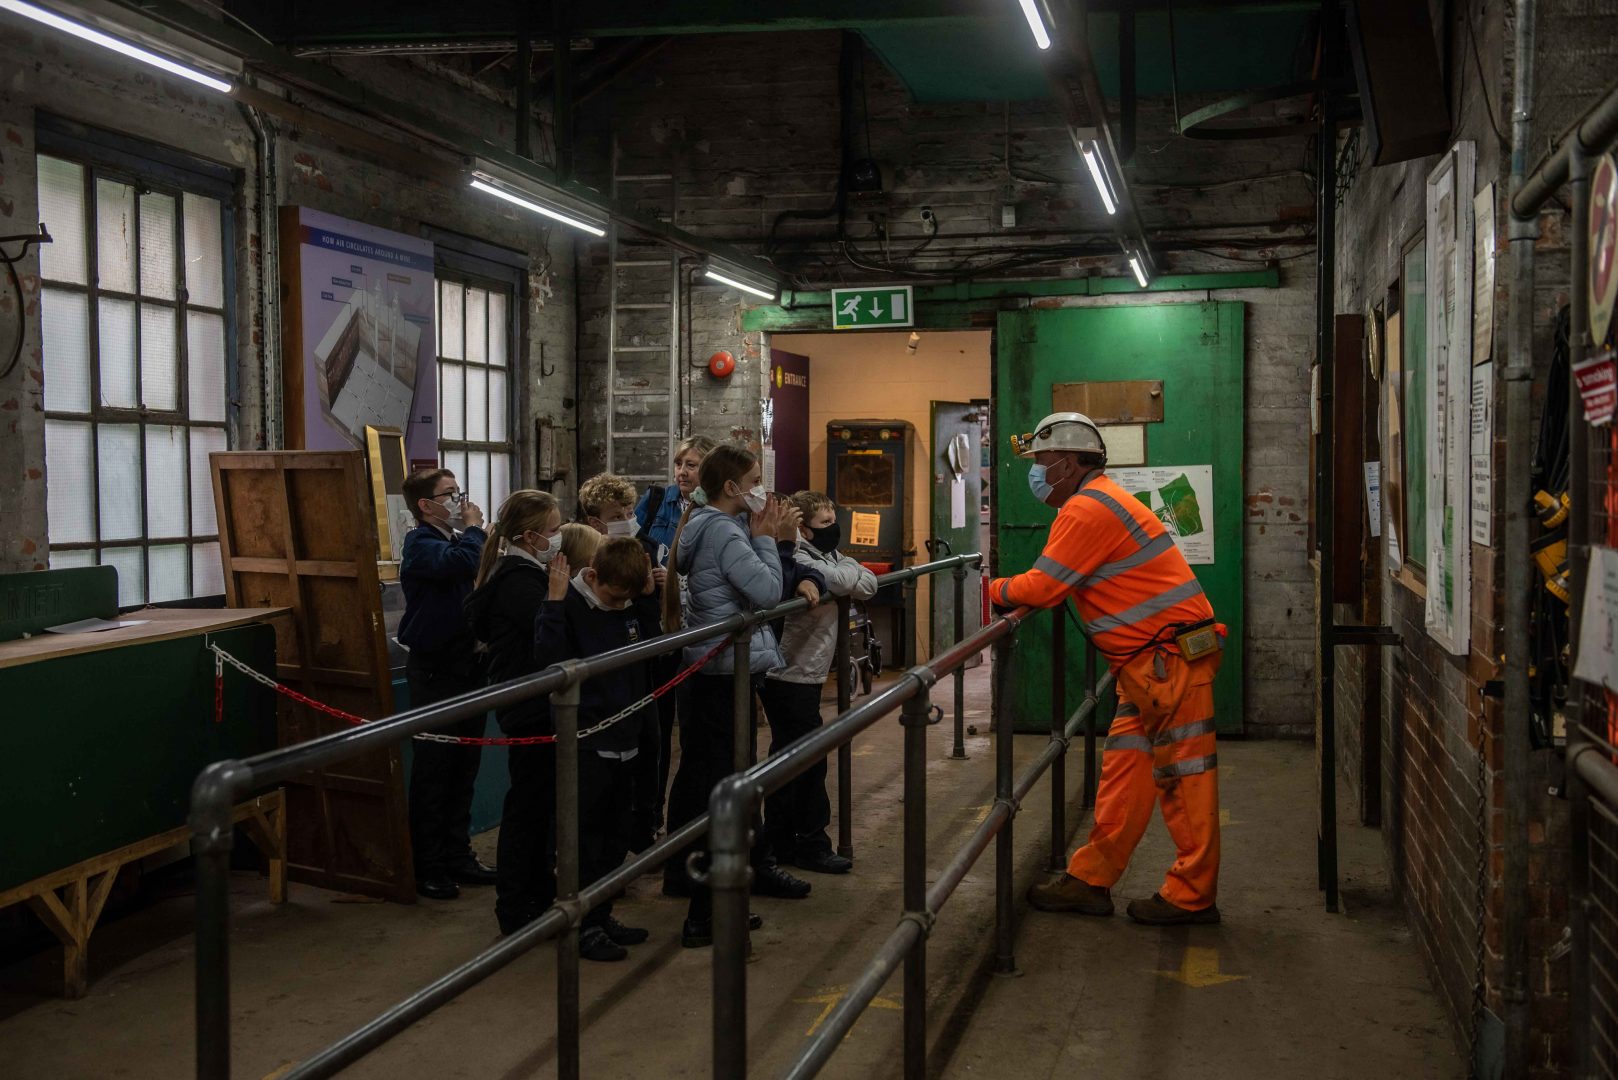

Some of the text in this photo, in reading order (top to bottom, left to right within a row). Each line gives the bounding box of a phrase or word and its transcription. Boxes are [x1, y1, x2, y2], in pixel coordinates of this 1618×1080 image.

[322, 235, 334, 245] HOW
[336, 238, 345, 248] AIR
[346, 241, 374, 255] CIRCULATES
[375, 248, 393, 260] AROUND
[784, 372, 807, 388] ENTRANCE
